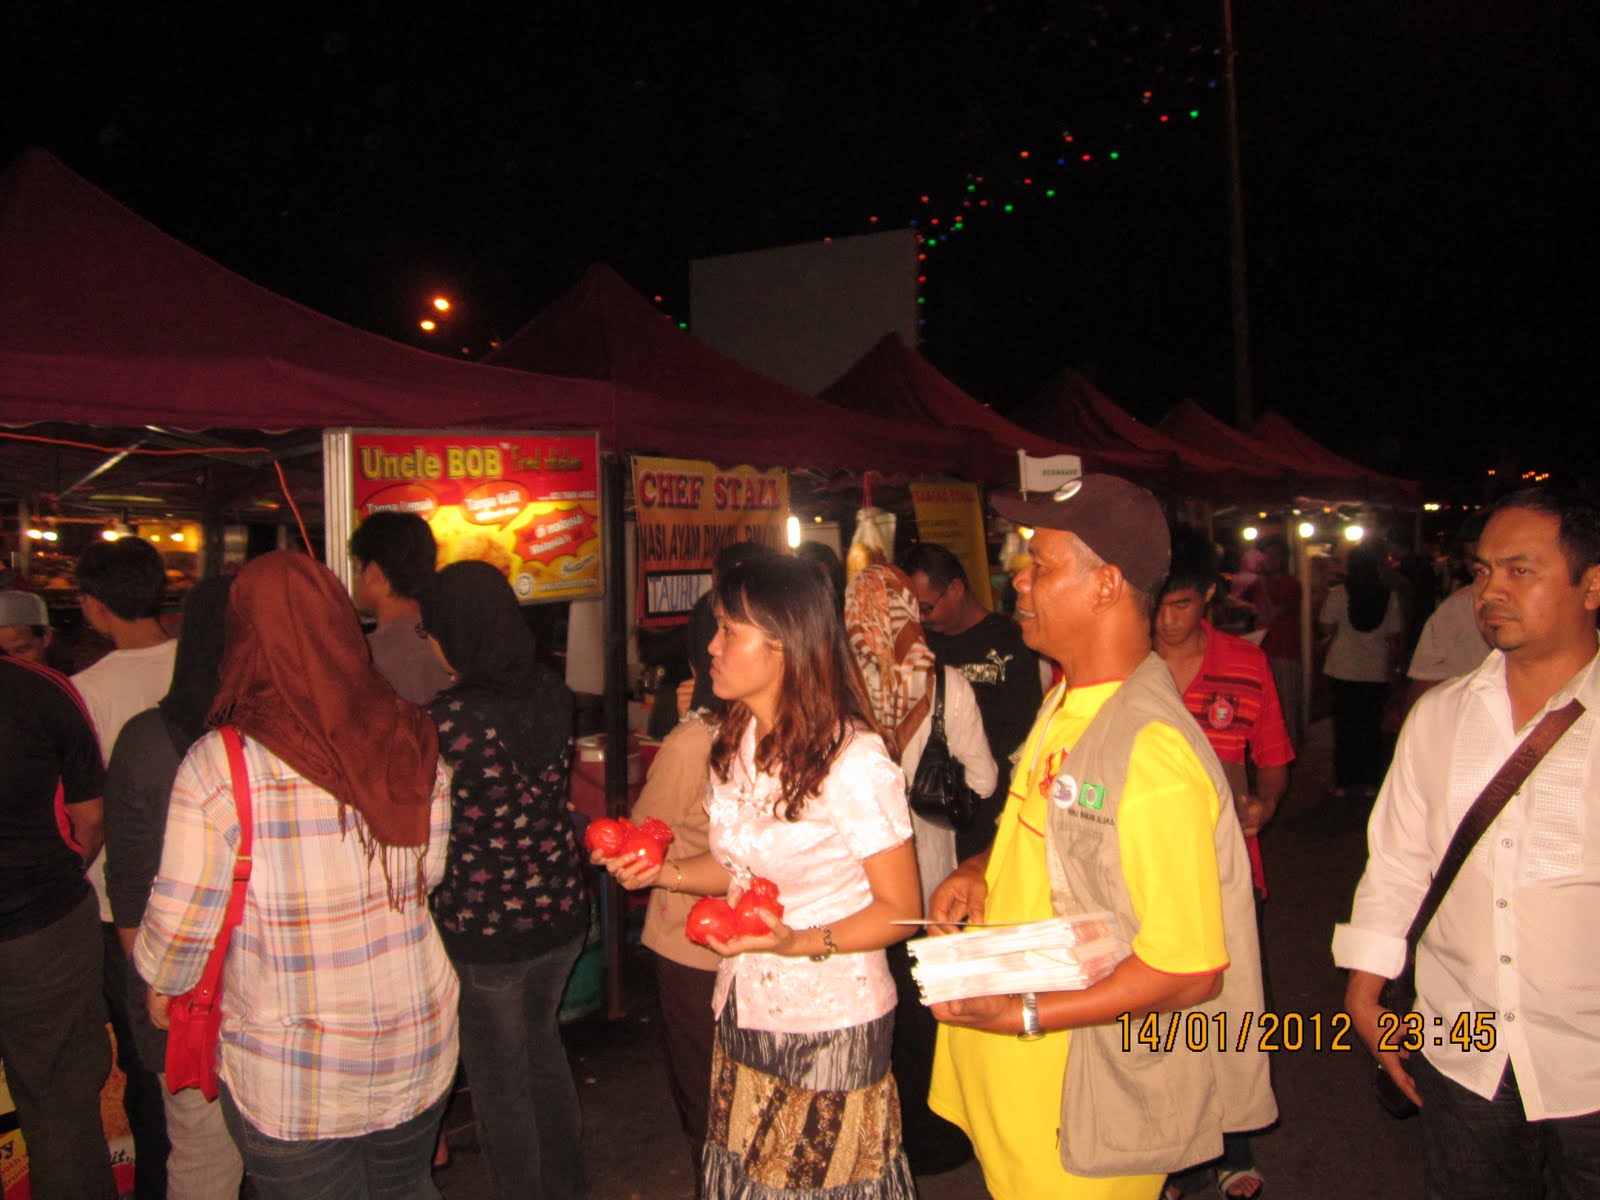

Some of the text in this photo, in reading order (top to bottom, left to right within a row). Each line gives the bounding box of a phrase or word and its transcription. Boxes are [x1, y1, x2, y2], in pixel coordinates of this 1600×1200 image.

[360, 446, 440, 480] Uncle
[447, 446, 502, 478] BOB
[639, 471, 781, 511] CHEF STALL
[669, 523, 701, 562] AYAM
